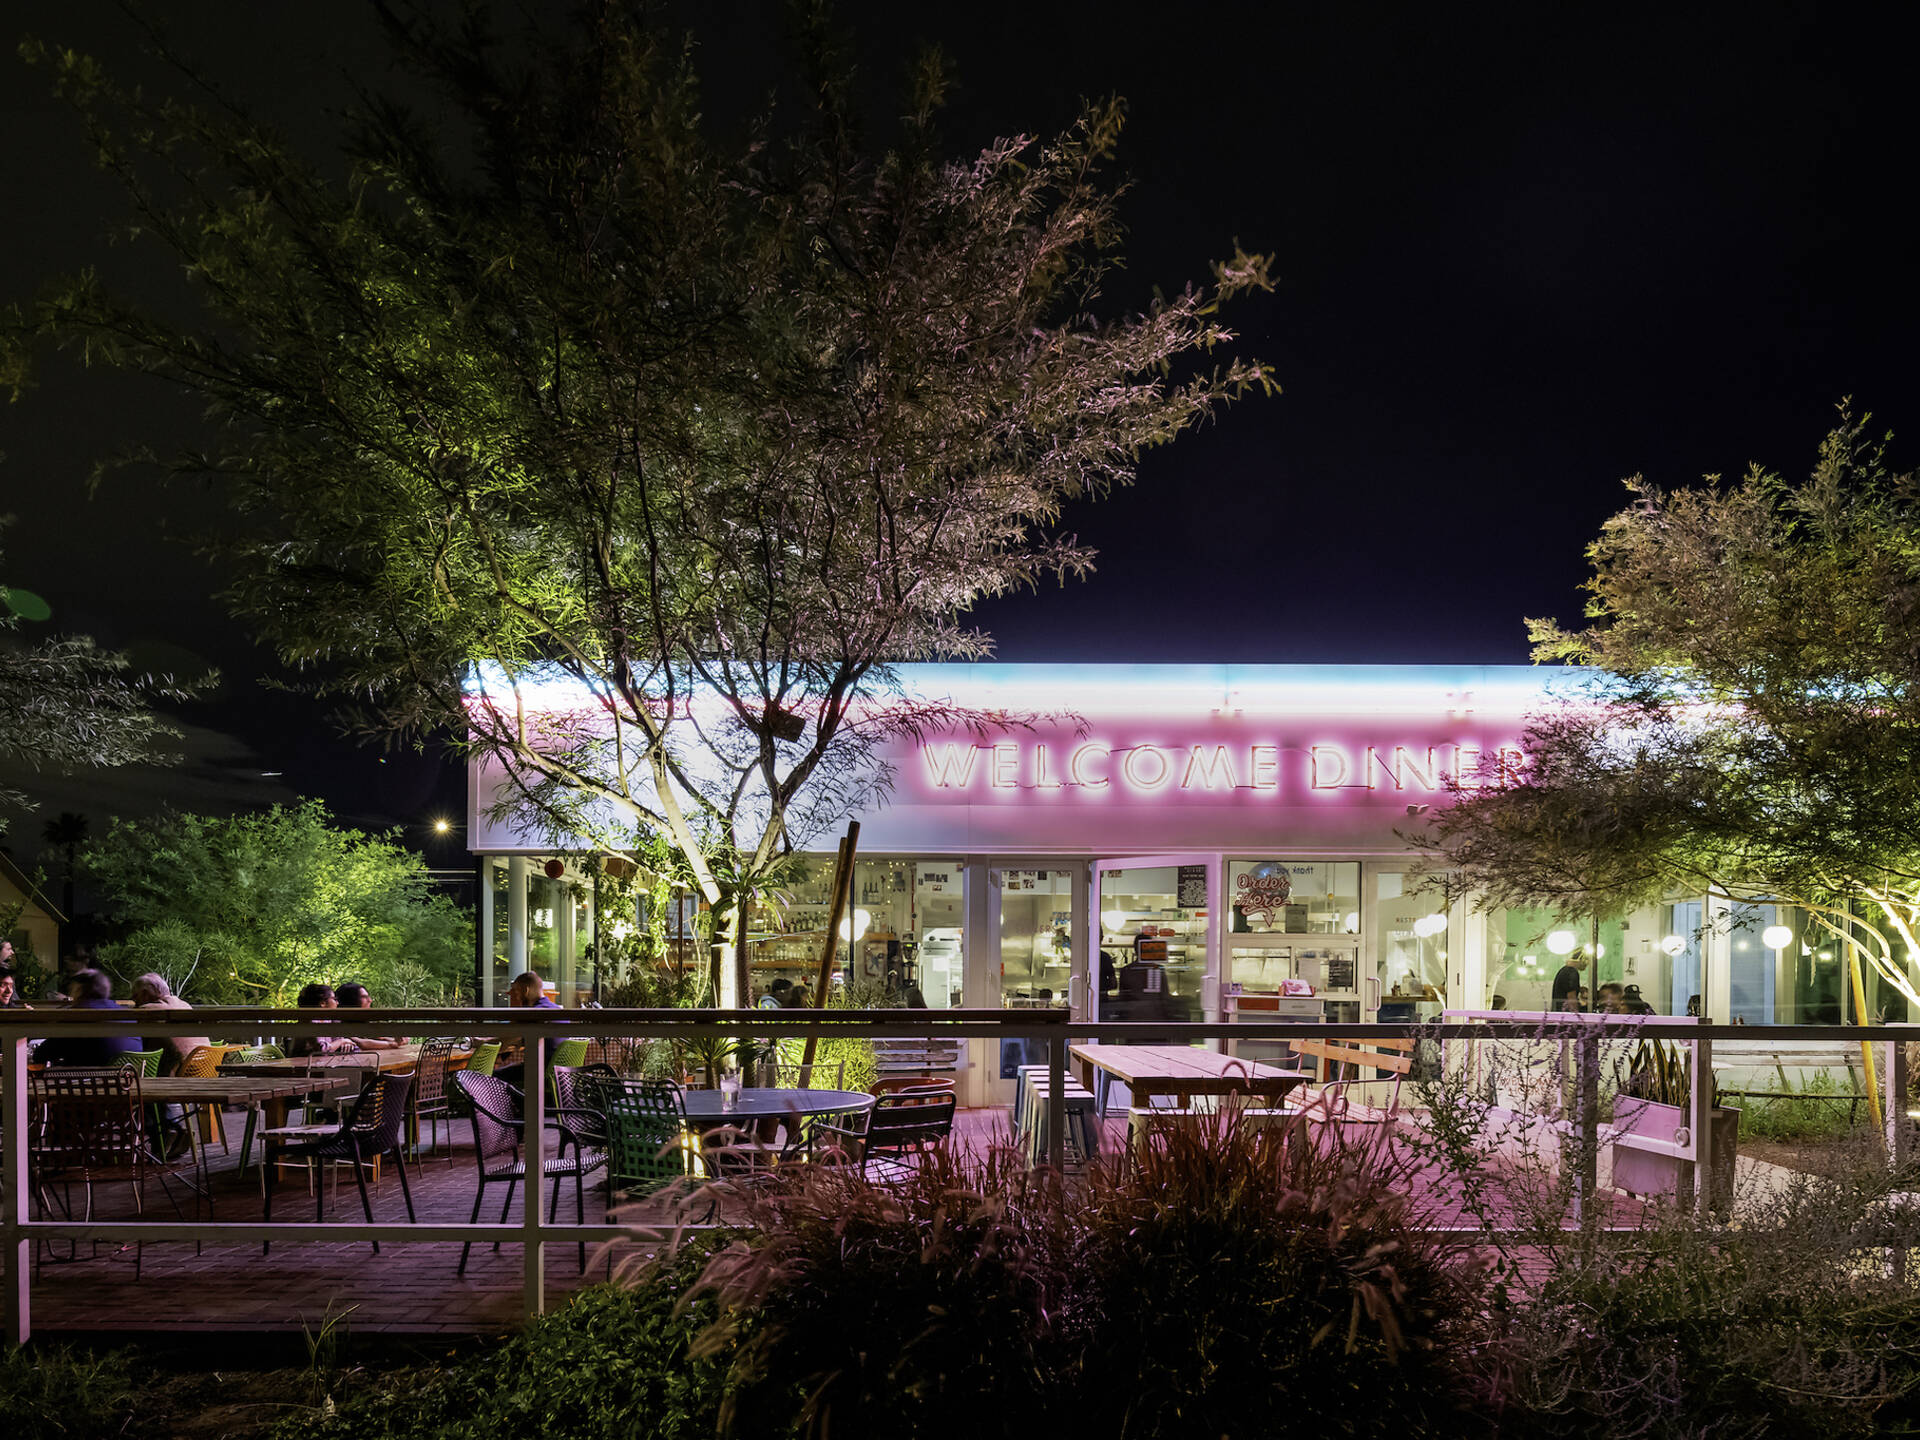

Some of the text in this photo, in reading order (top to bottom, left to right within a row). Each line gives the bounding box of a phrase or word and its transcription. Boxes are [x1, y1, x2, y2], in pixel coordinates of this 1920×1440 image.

[922, 744, 1528, 790] WELCOME DINER
[1237, 873, 1290, 889] Order
[1235, 891, 1292, 908] Here
